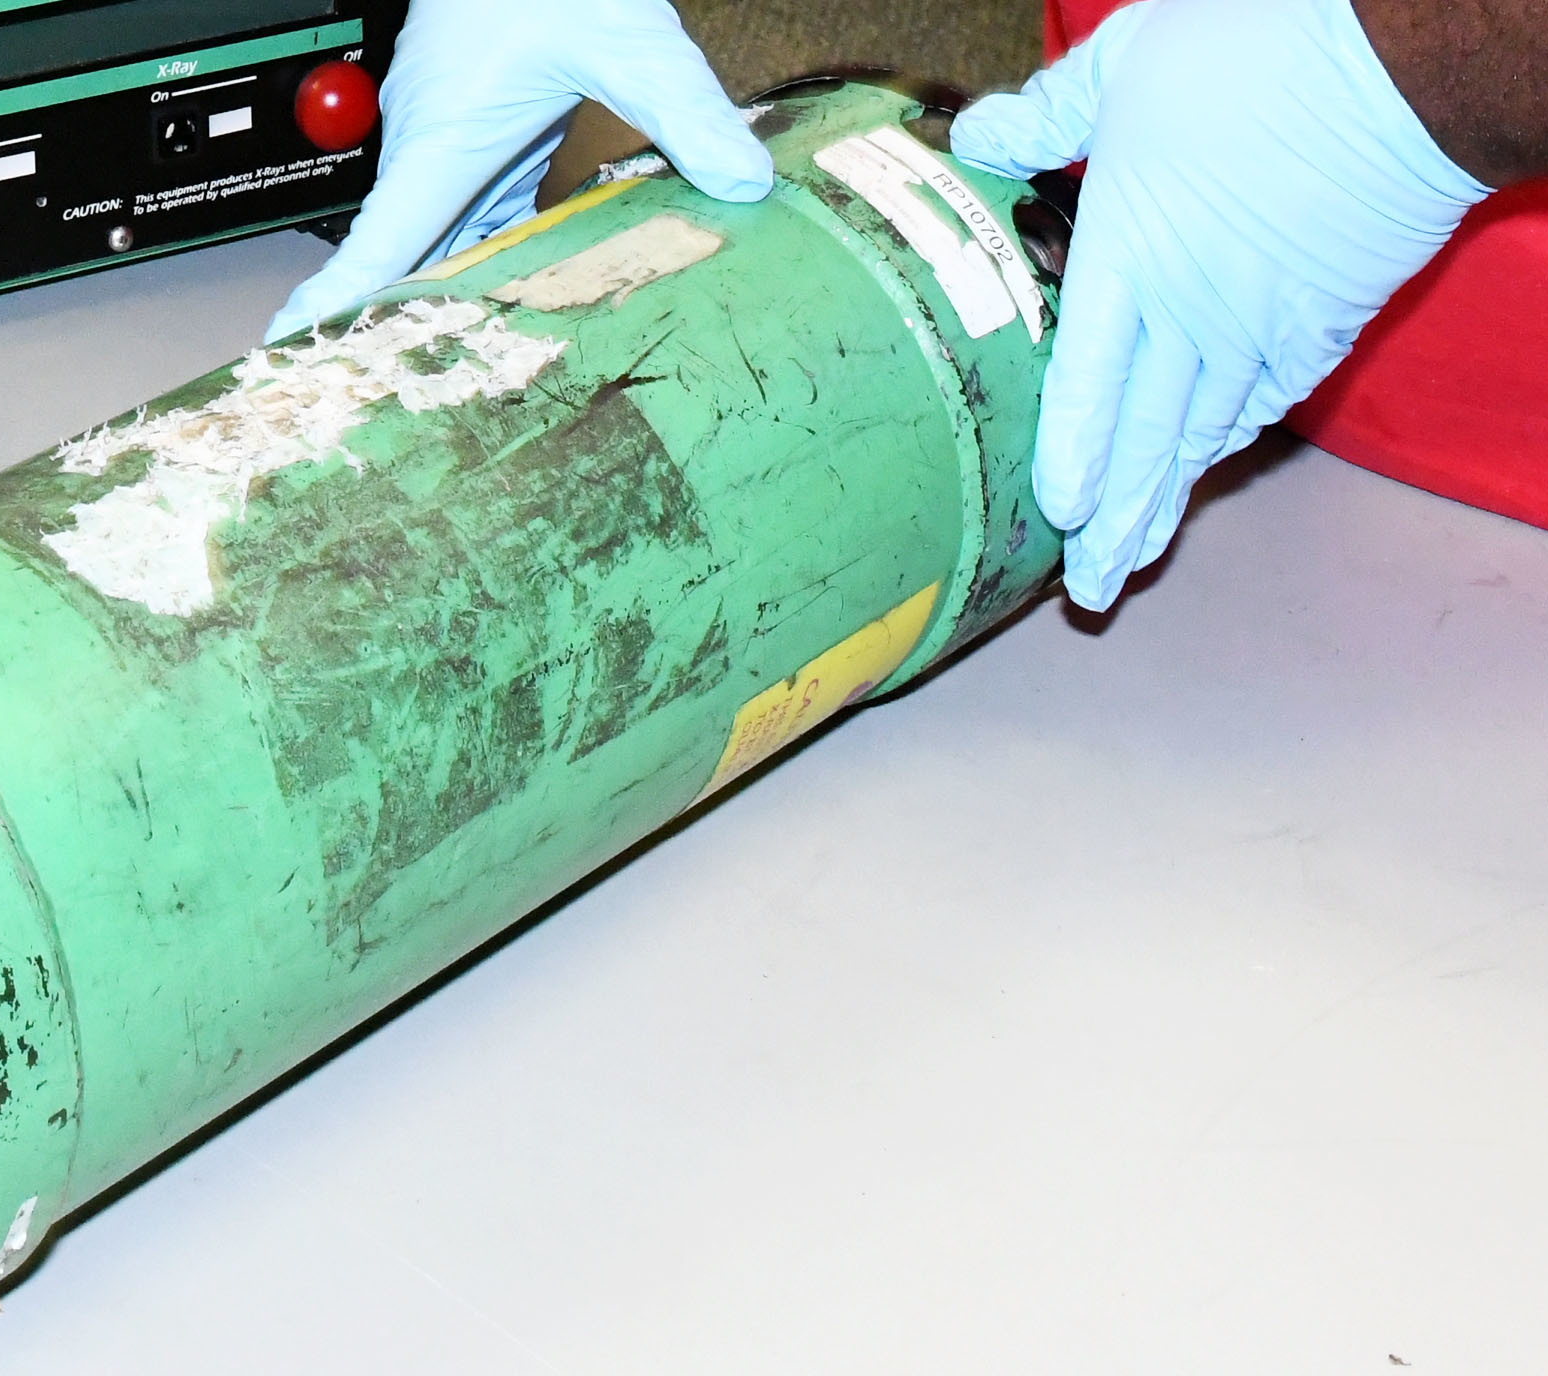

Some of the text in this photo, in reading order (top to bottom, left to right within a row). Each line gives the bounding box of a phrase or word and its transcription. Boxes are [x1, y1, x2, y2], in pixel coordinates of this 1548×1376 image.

[343, 49, 363, 62] Off
[156, 59, 198, 80] X-Ray
[150, 89, 169, 104] On
[132, 163, 335, 217] To be operated by qualified personnel only.
[134, 191, 154, 205] This
[156, 181, 208, 203] equipment
[209, 171, 253, 191] produces
[255, 162, 286, 180] X-Rays
[288, 157, 315, 172] when
[62, 196, 124, 221] CAUTION:
[931, 172, 1014, 265] RP10702
